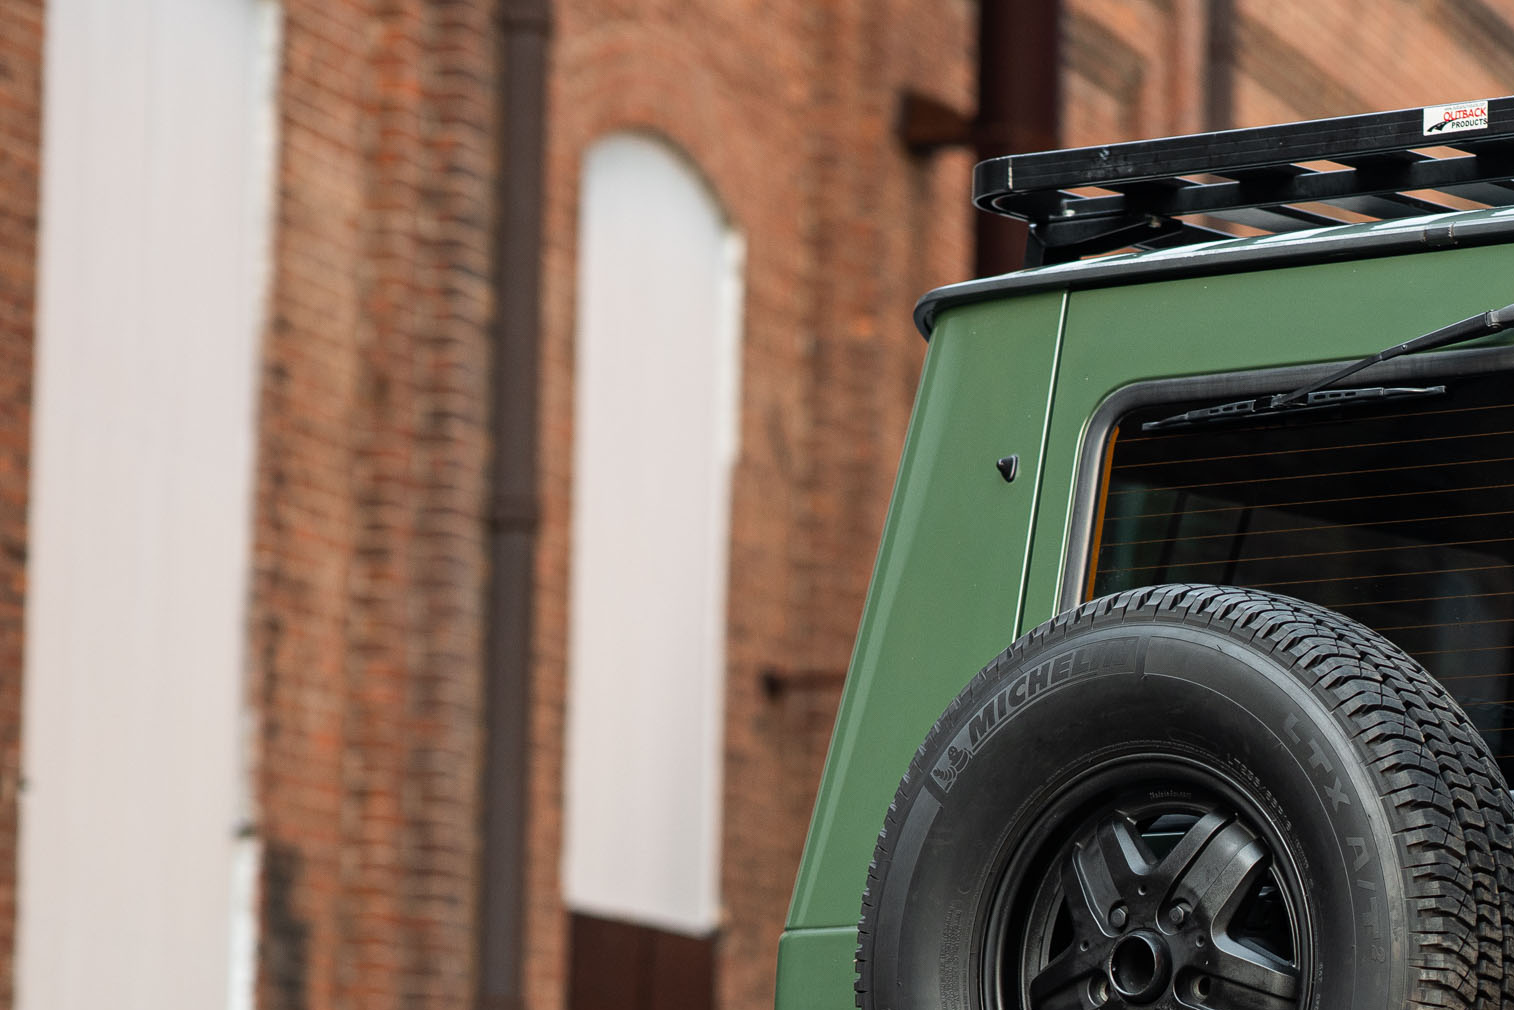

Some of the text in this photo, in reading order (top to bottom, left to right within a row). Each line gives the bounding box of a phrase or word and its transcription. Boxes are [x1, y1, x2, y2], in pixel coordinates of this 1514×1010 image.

[1443, 107, 1487, 122] OUTBACK
[1451, 118, 1488, 129] PRODUCTS
[968, 637, 1136, 748] MICHELIN
[1281, 712, 1352, 815] LTX
